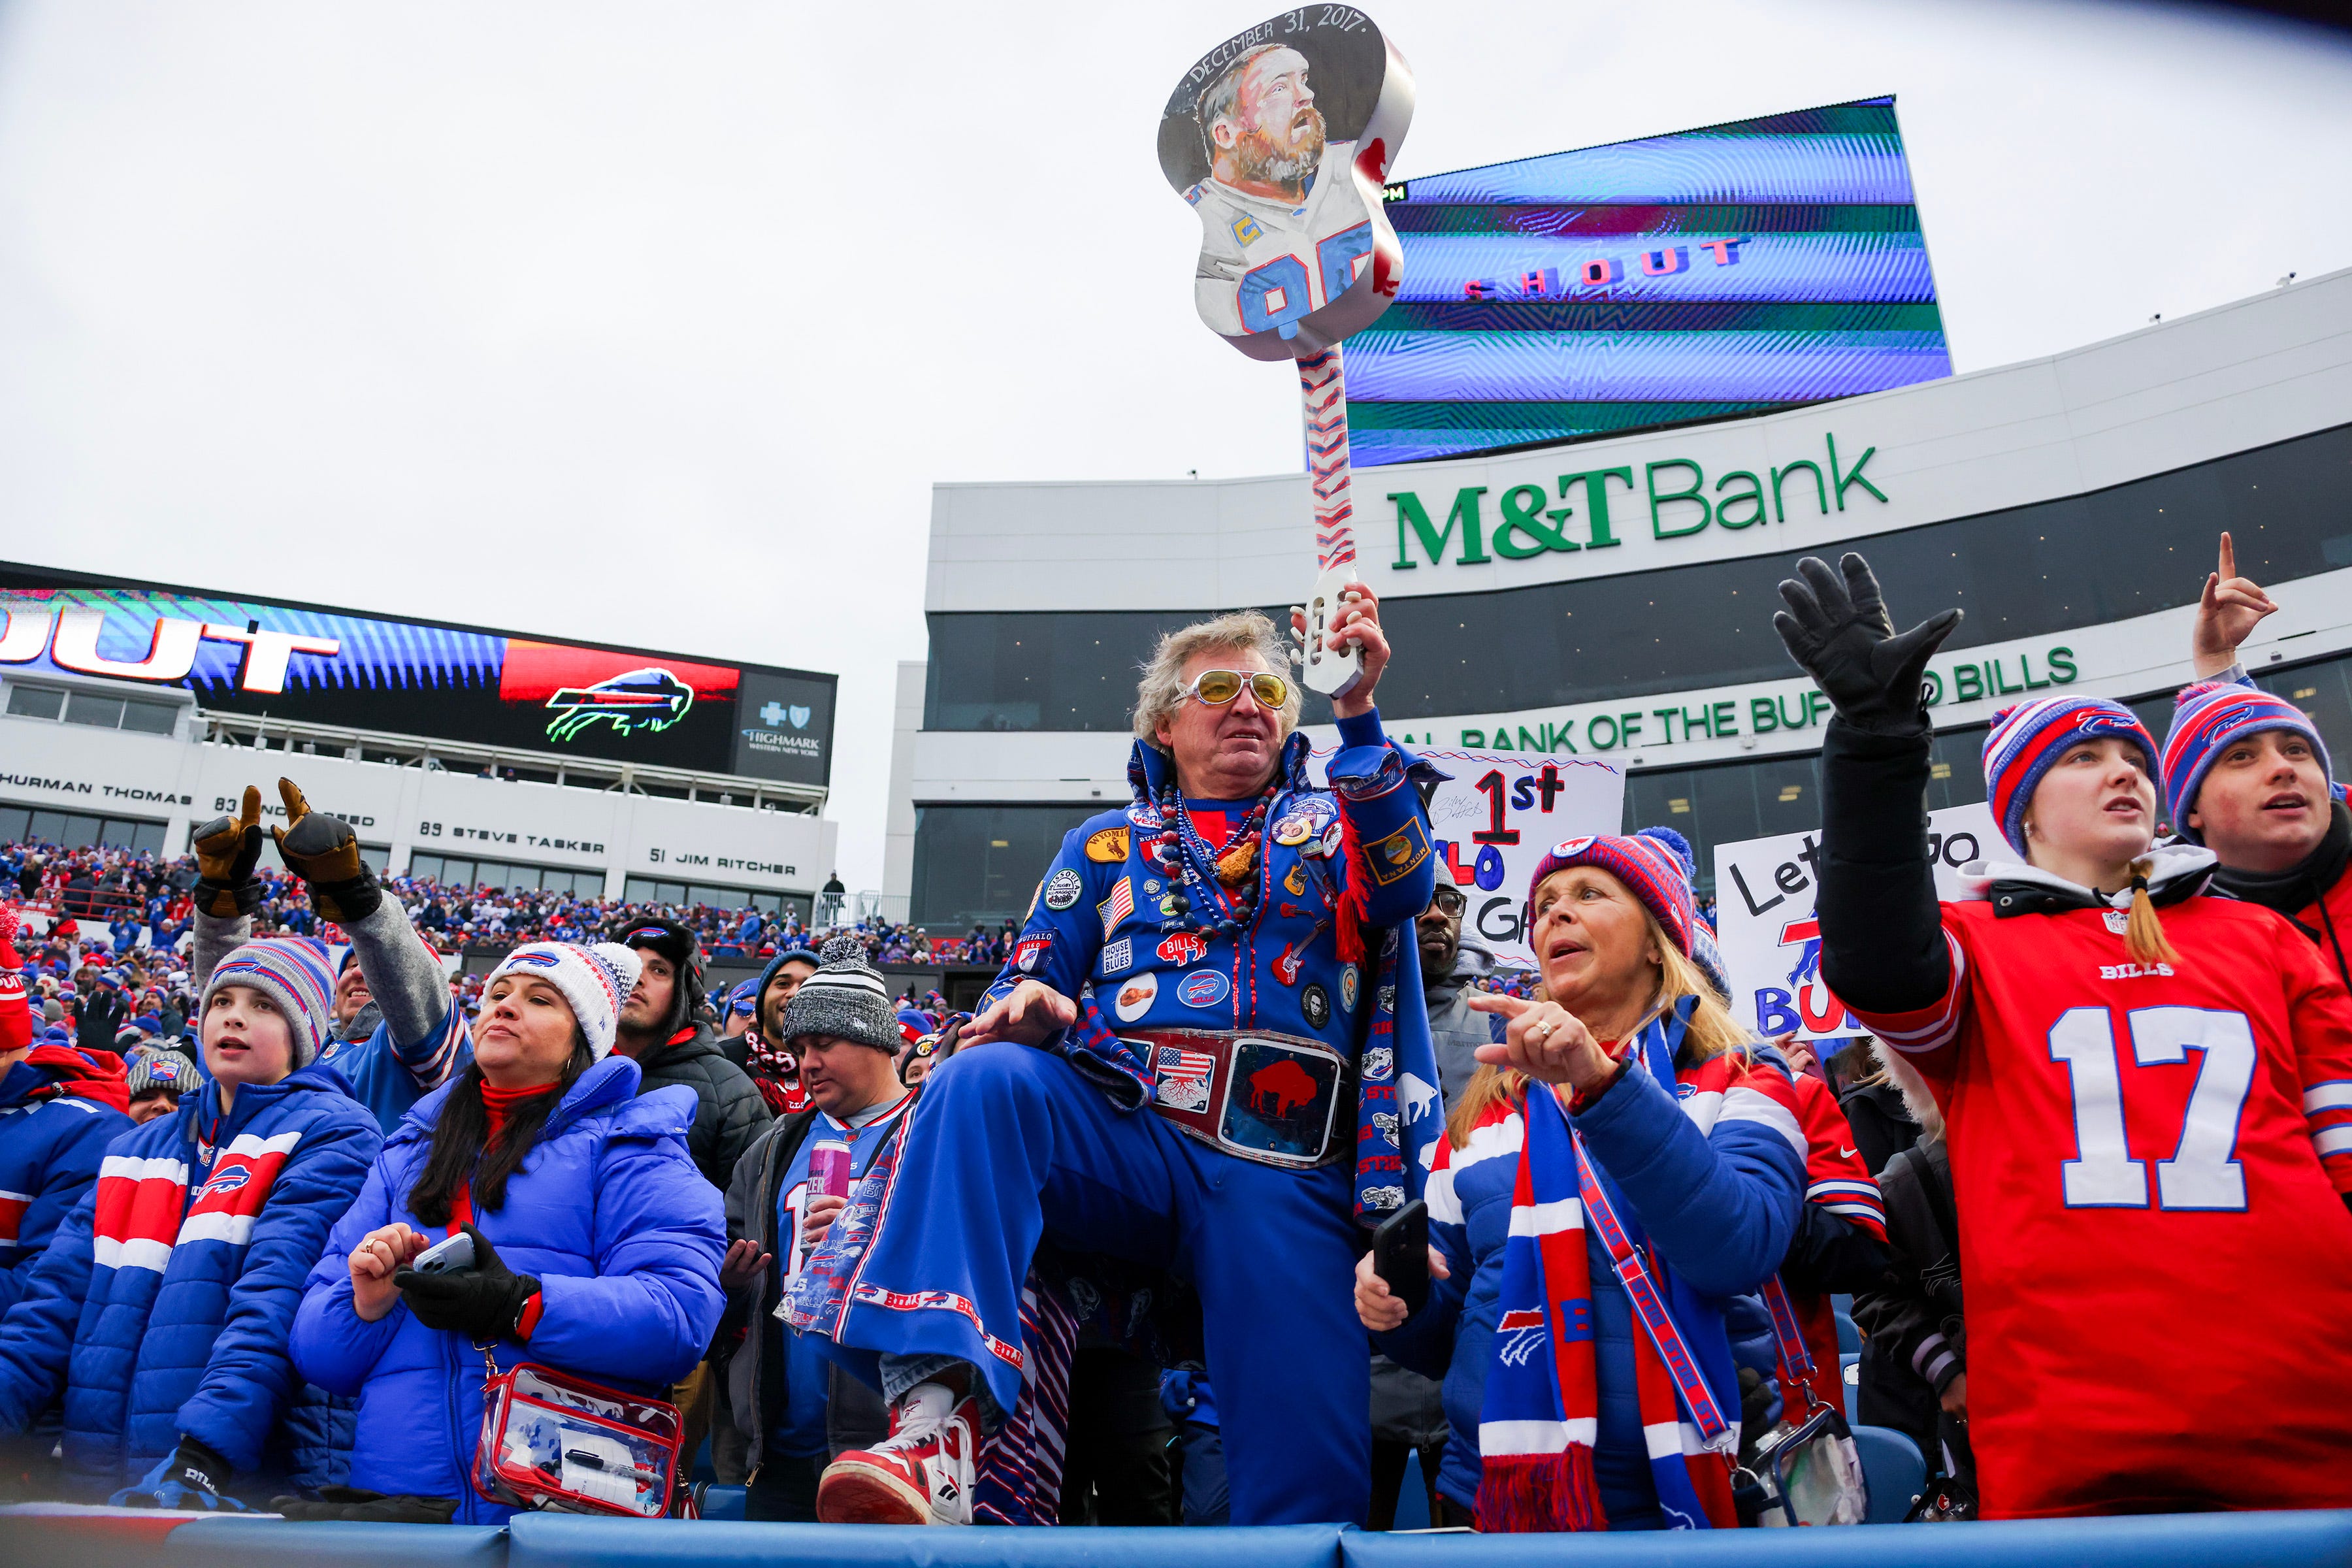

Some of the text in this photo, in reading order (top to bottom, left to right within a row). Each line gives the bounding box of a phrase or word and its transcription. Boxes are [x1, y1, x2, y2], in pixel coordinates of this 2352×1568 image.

[1189, 5, 1367, 84] DECEMBER 31, 2017.
[1464, 238, 1740, 301] SHOUT
[1387, 432, 1889, 570] M&T Bank
[1461, 720, 1577, 754] BANK
[1588, 711, 1642, 750] OF
[1653, 700, 1740, 743] THE
[1953, 646, 2078, 702] BILLS
[749, 731, 820, 750] HIGHMARK
[103, 786, 192, 805] THOMAS
[215, 796, 237, 813] 83
[1472, 765, 1565, 845] 1st
[1271, 815, 1295, 835] PHILLIPS
[420, 821, 604, 854] 89 STEVE TASKER
[650, 847, 795, 876] 51 JIM RITCHER
[1381, 847, 1426, 880] MONTANA
[1049, 871, 1081, 891] MISSOULA
[1018, 933, 1052, 943] BUFFALO
[1022, 942, 1040, 951] 1960
[1105, 942, 1128, 956] HOUSE
[1166, 936, 1199, 954] BILLS
[1105, 956, 1130, 971] BLUES
[2099, 962, 2175, 980] BILLS
[1191, 996, 1215, 1004] BILLS
[2047, 1005, 2257, 1211] 17
[1590, 1198, 1624, 1247] BILLS
[884, 1292, 921, 1309] BILLS
[1631, 1277, 1667, 1328] BILLS
[993, 1339, 1024, 1369] BILLS
[1663, 1337, 1699, 1390] BILLS
